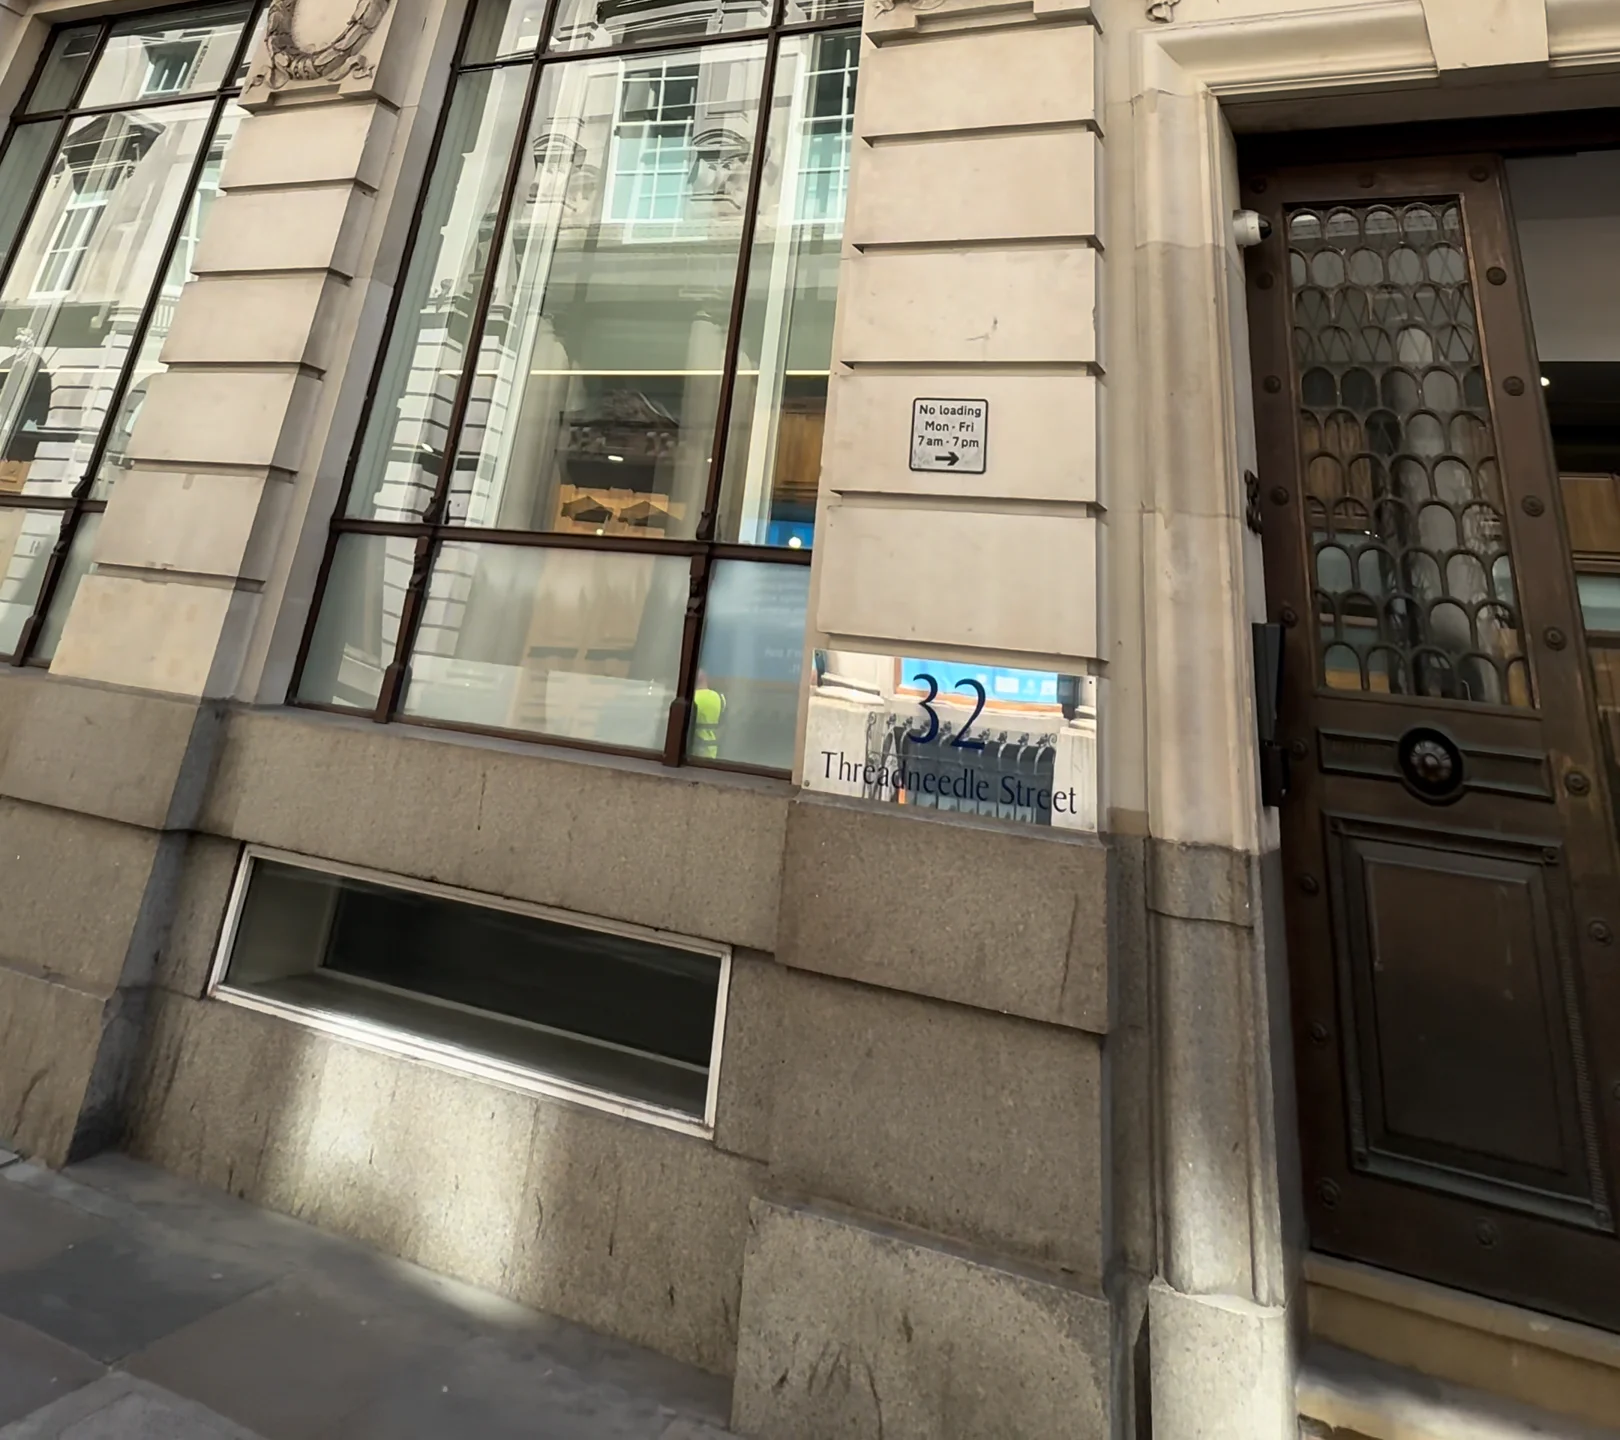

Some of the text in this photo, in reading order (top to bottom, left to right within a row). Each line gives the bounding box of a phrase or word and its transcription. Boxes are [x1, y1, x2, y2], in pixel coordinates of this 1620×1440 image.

[919, 404, 982, 418] No loading
[924, 421, 949, 432] Mon
[958, 422, 975, 433] Fri
[907, 673, 986, 750] 32
[820, 750, 1078, 815] Threadneedle Street
